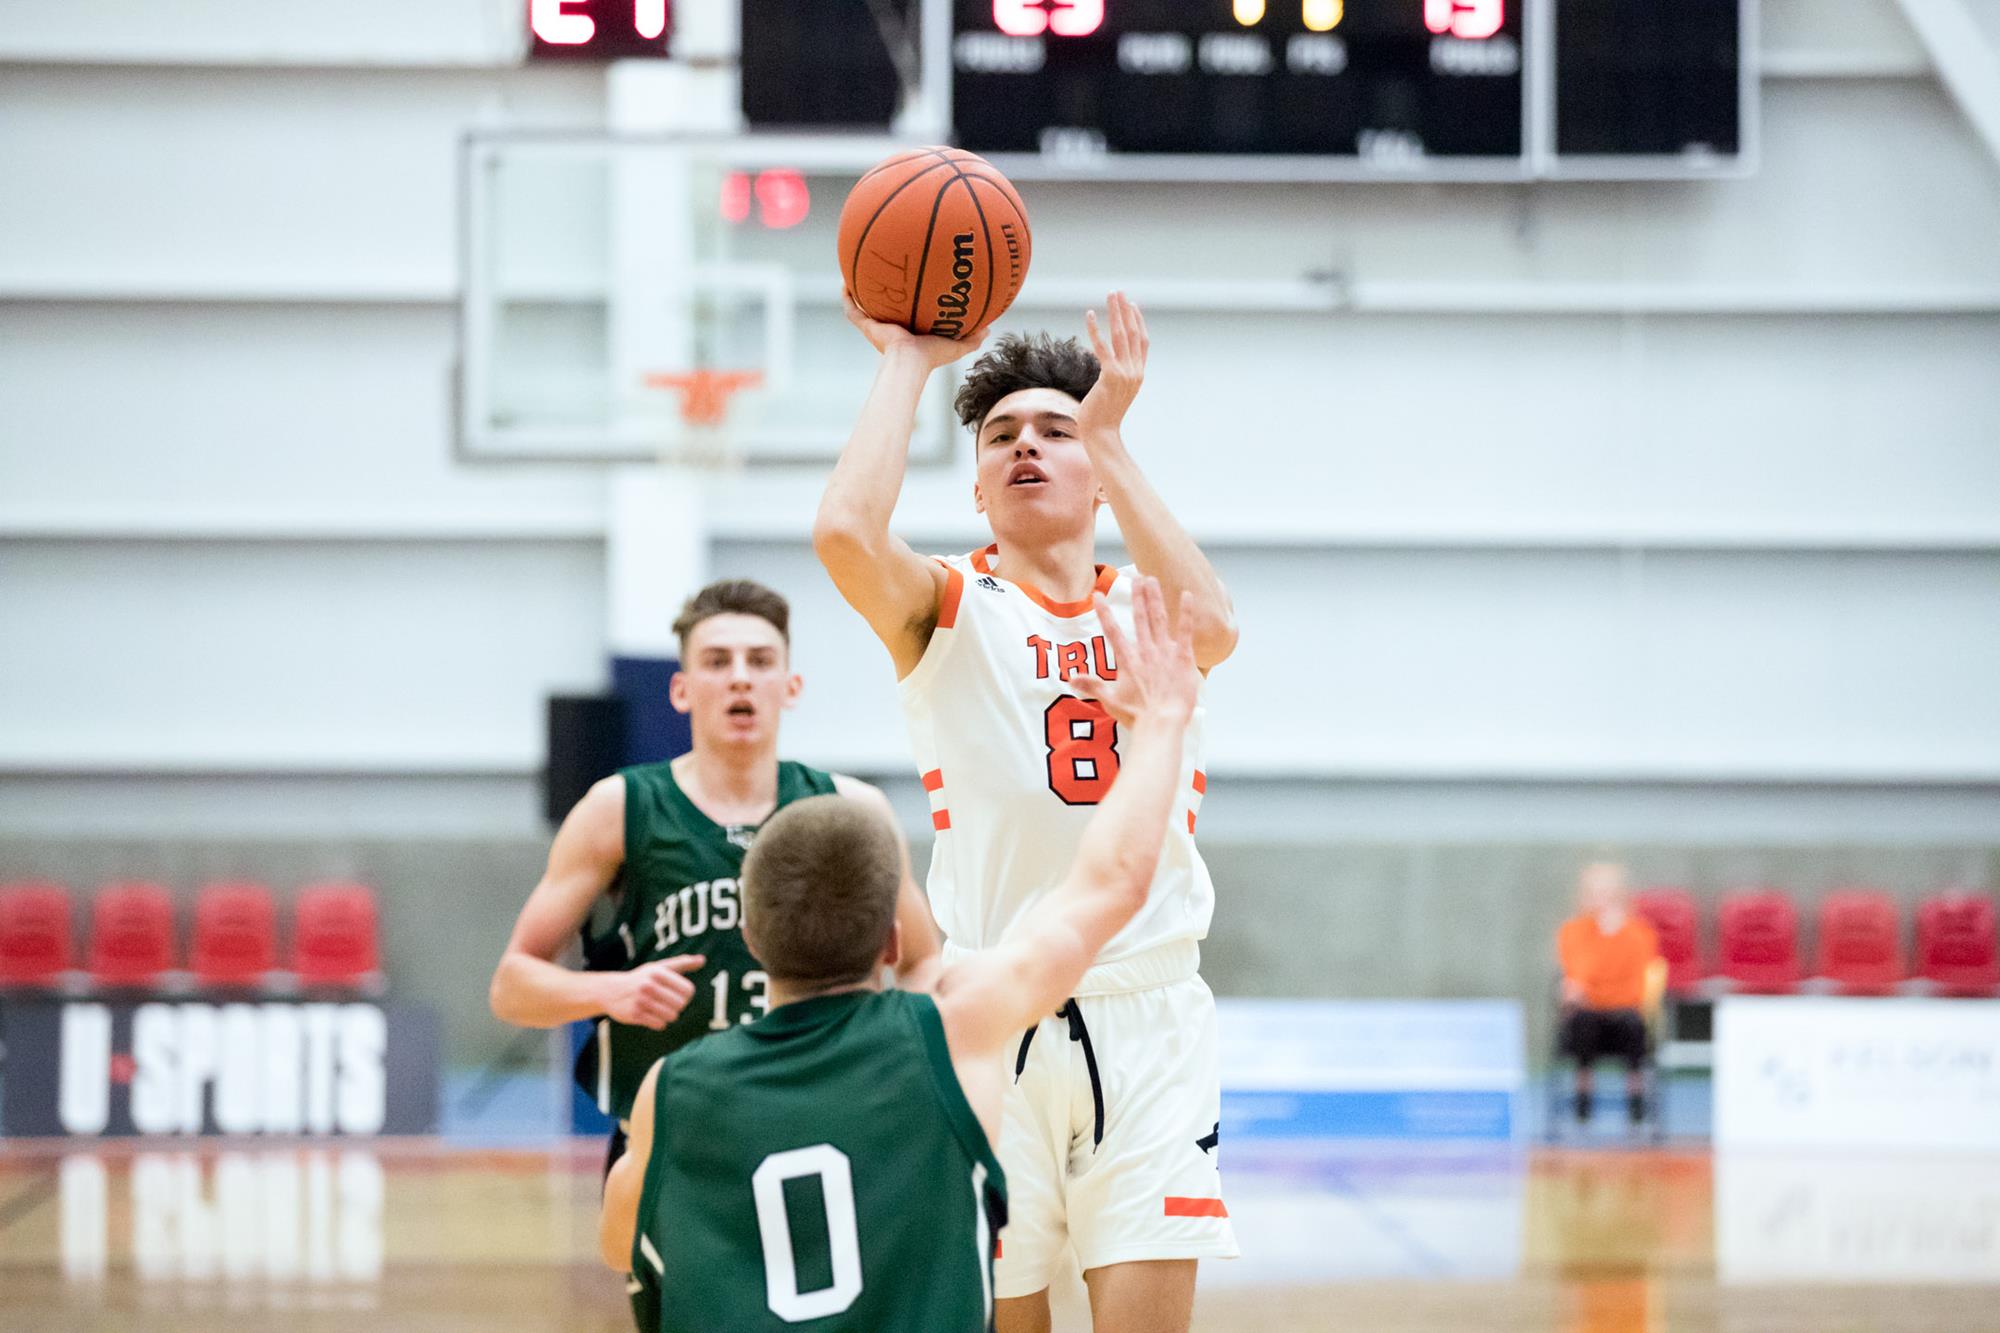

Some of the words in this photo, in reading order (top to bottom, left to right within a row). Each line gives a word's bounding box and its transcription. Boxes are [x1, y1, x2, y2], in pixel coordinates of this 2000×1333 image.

[931, 232, 975, 339] Wilson
[1027, 634, 1118, 682] TRU
[1044, 694, 1121, 806] 8
[654, 877, 746, 951] HUS
[709, 970, 769, 1030] 13
[752, 1143, 863, 1323] 0
